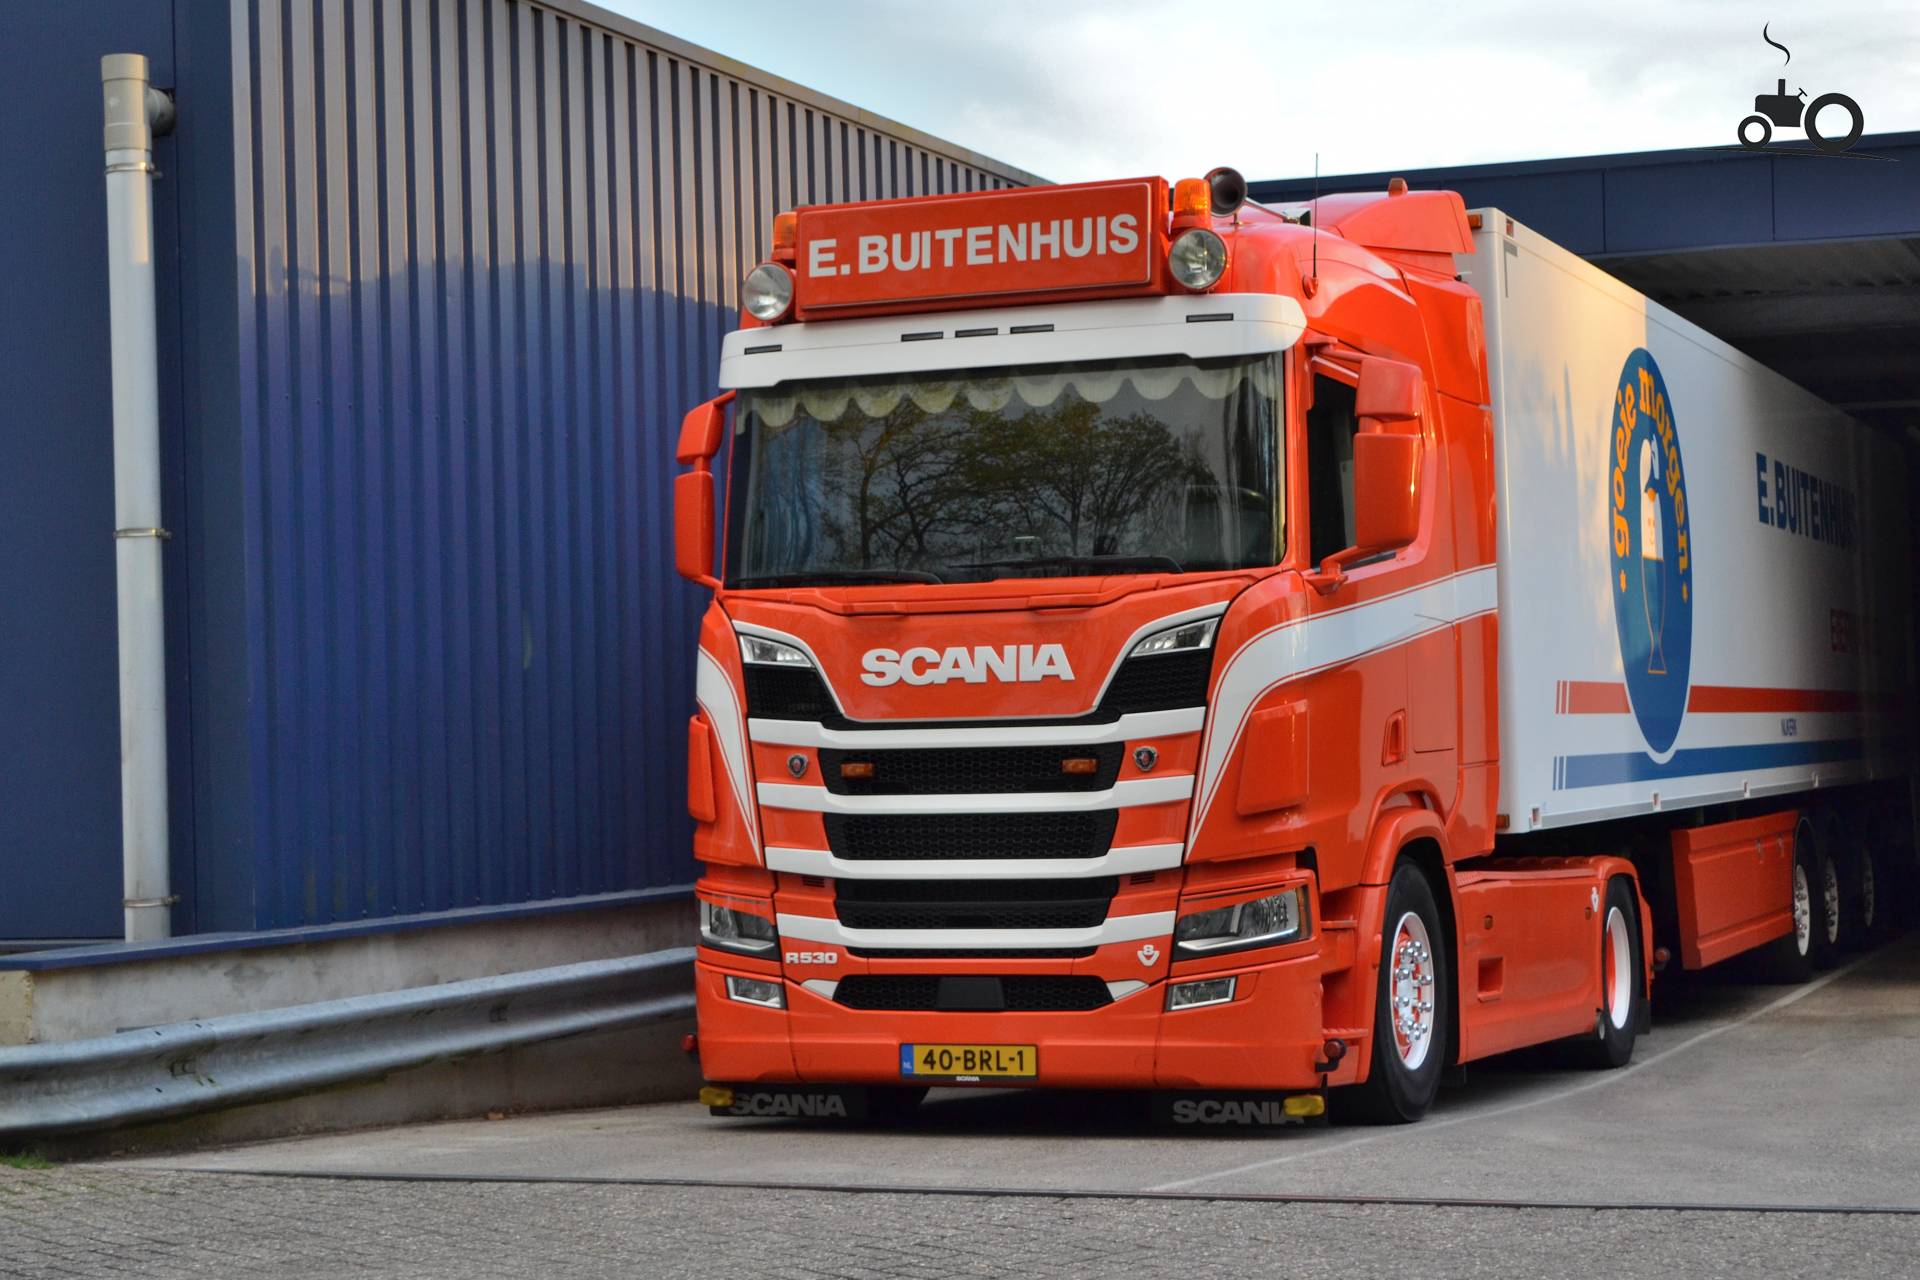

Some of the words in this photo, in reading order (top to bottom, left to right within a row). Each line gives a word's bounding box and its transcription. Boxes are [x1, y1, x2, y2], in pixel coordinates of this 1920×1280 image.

[1638, 366, 1689, 574] morgen
[860, 643, 1076, 687] SCANIA
[922, 1048, 1025, 1072] 40-BRL-1
